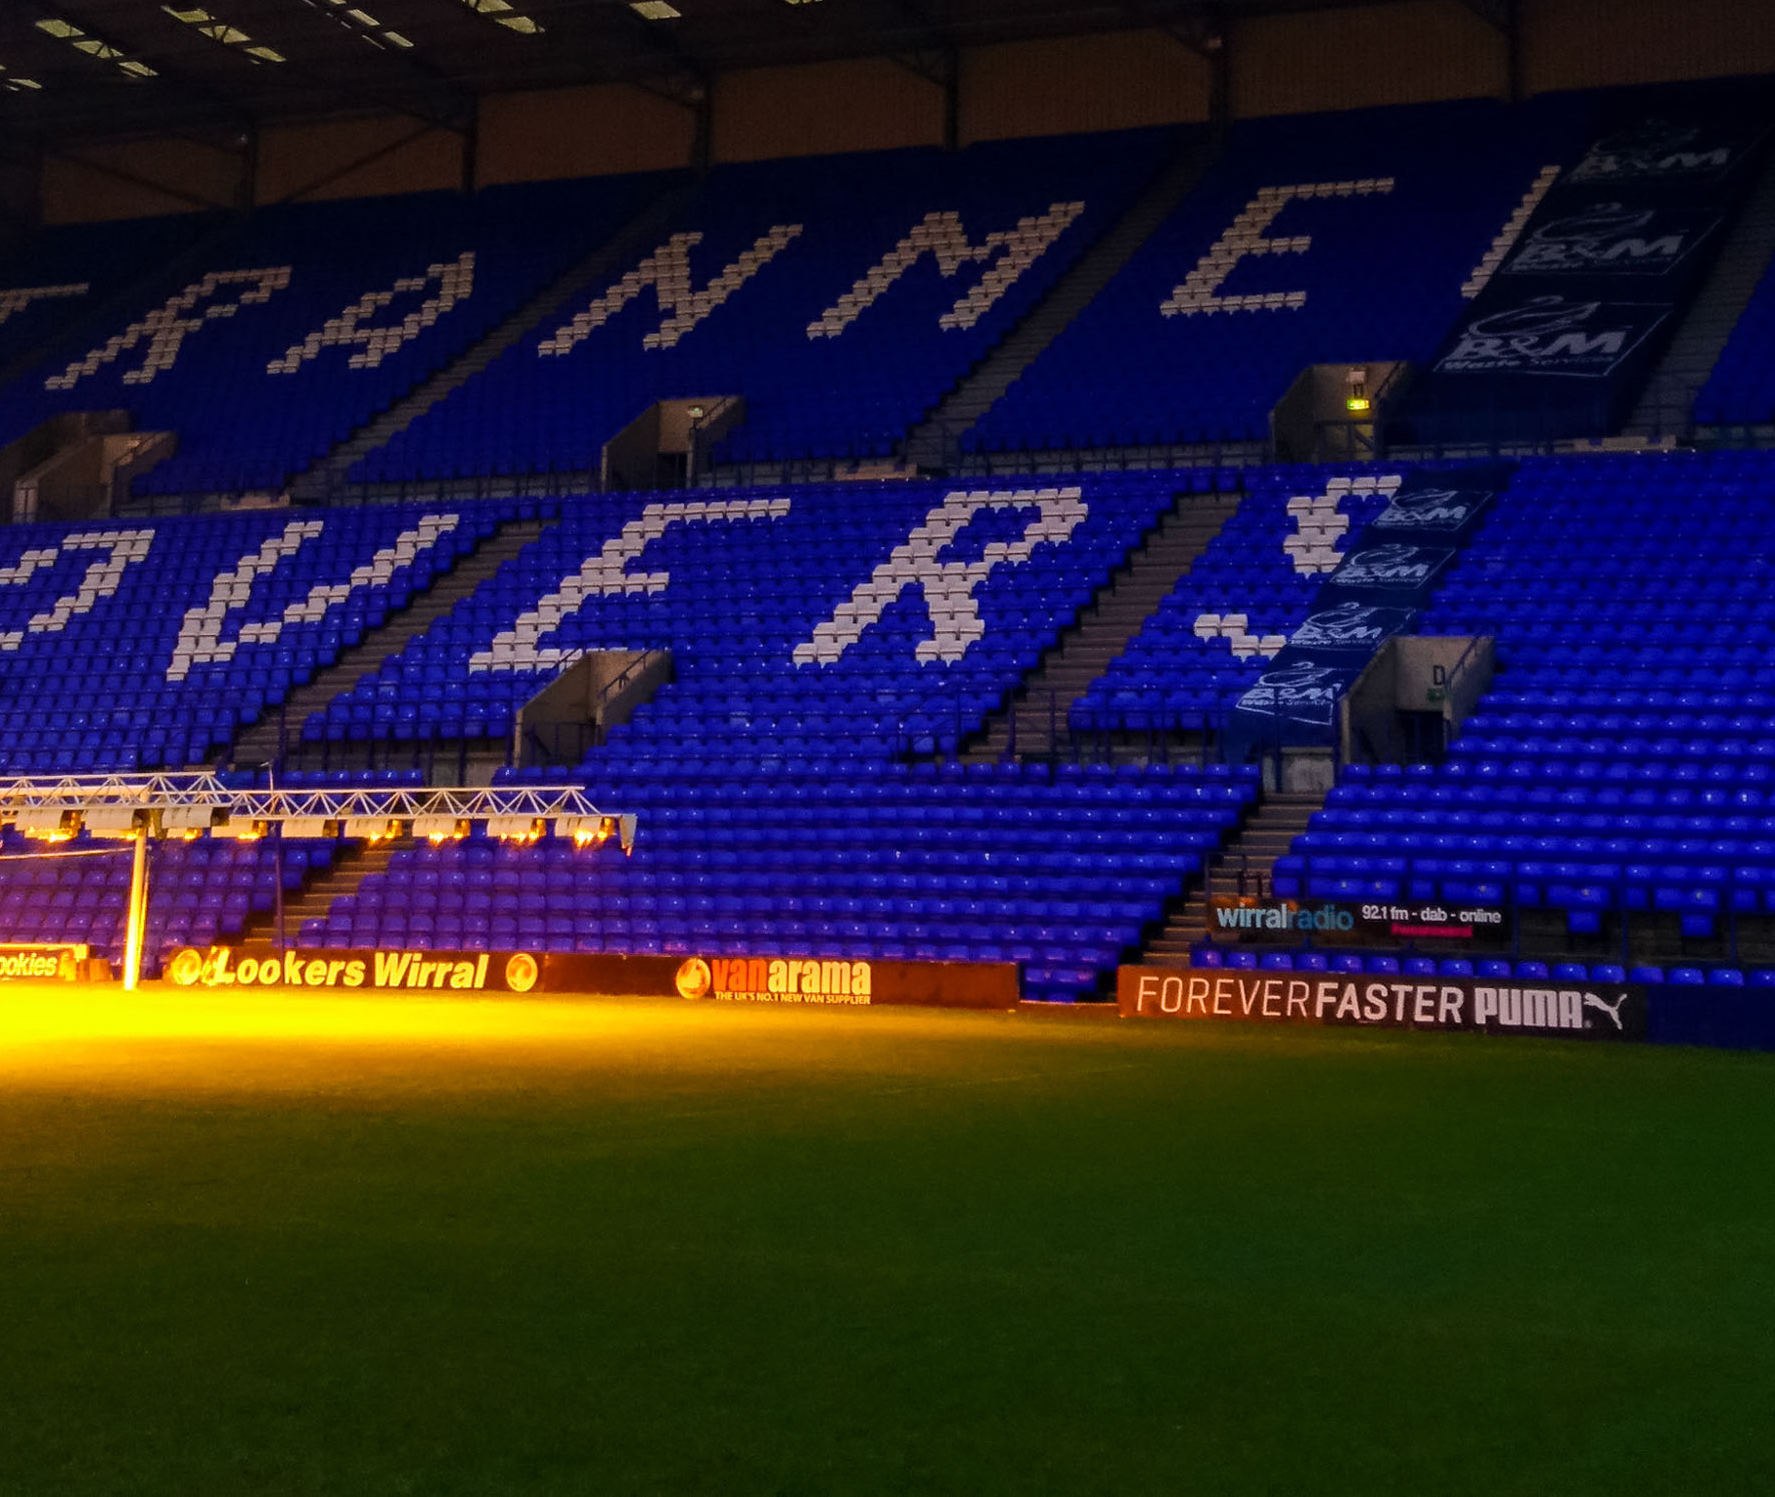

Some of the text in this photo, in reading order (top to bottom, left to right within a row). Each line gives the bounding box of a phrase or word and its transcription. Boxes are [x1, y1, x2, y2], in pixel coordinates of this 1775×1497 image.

[1390, 905, 1410, 921] fm
[1420, 907, 1448, 923] dab
[1459, 909, 1503, 924] online
[212, 948, 491, 990] Lookers Wirral
[711, 959, 872, 995] vanarama
[714, 990, 733, 1001] THE
[780, 993, 804, 1004] NEW
[804, 994, 825, 1004] VAN
[825, 994, 871, 1005] SUPPLIER
[1474, 987, 1584, 1028] PUMA
